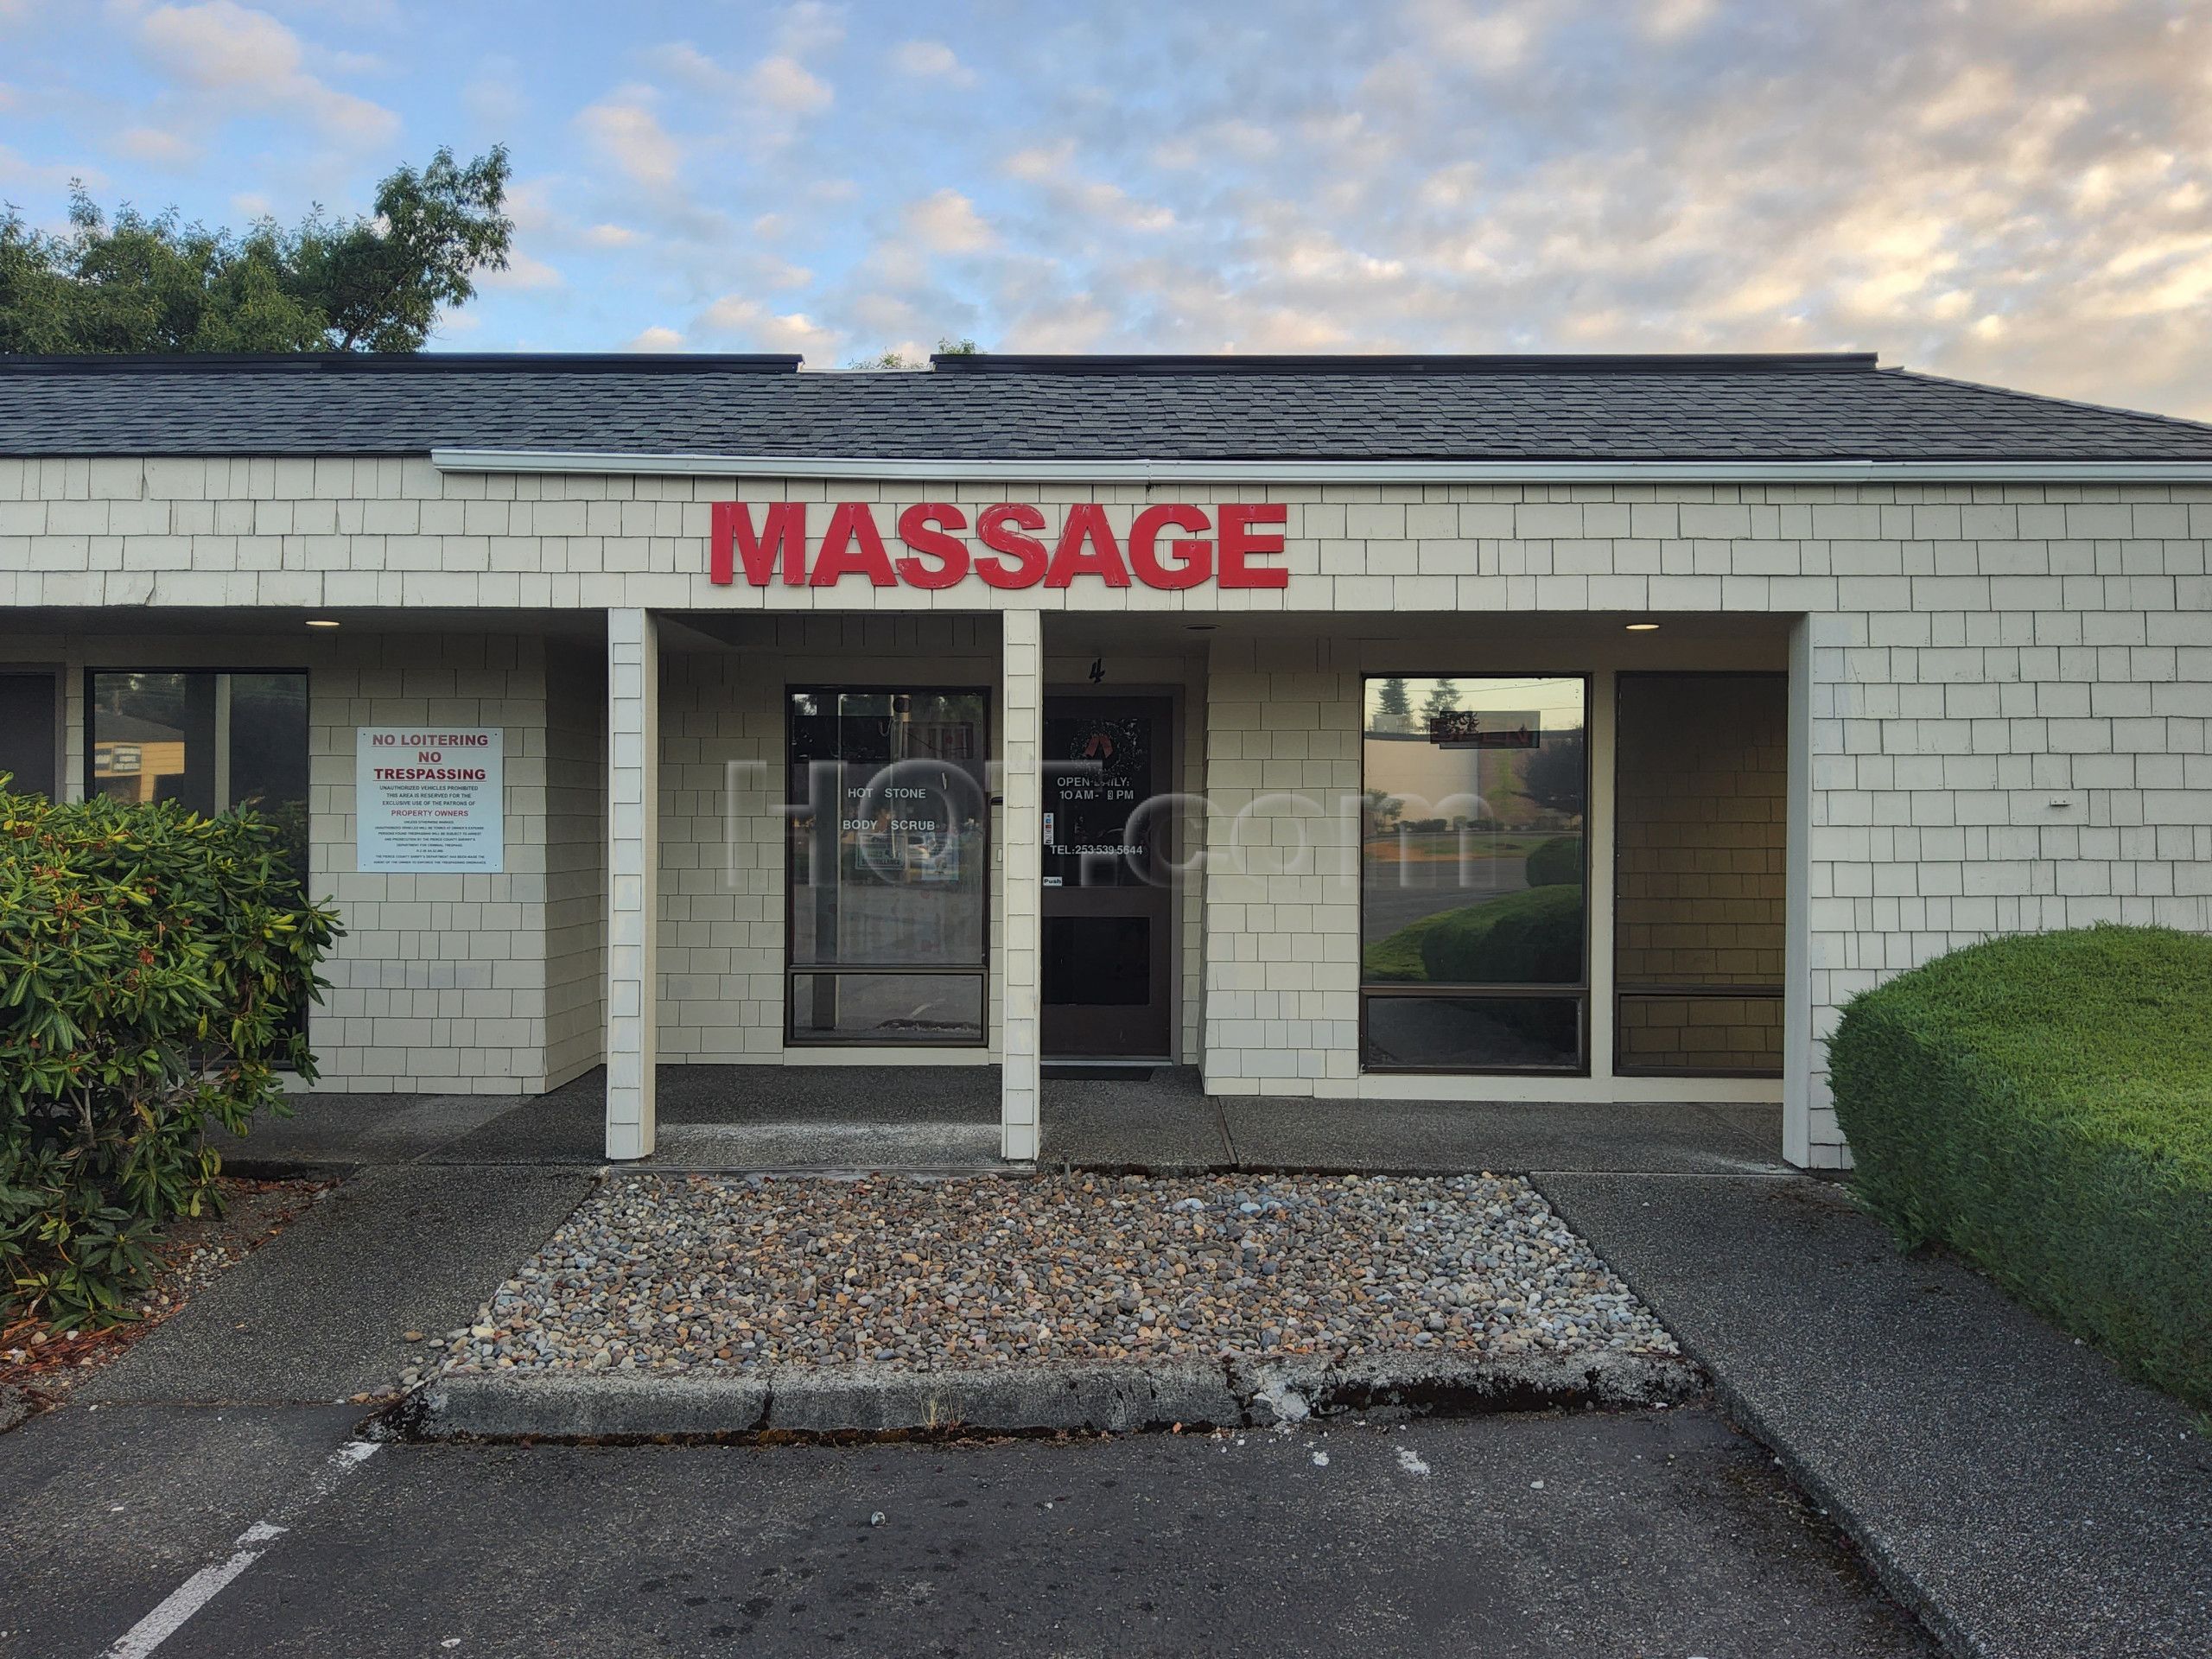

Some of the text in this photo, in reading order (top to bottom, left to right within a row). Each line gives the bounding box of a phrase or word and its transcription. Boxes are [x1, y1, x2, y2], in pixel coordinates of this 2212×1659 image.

[710, 501, 1288, 590] MASSAGE
[1089, 658, 1105, 683] 4
[372, 734, 488, 746] NO LOITERING
[418, 752, 442, 763] NO
[373, 768, 486, 780] TRESPASSING
[1057, 777, 1090, 787] OPEN
[848, 788, 926, 798] HOT STONE
[842, 820, 935, 830] BODY SCRUB
